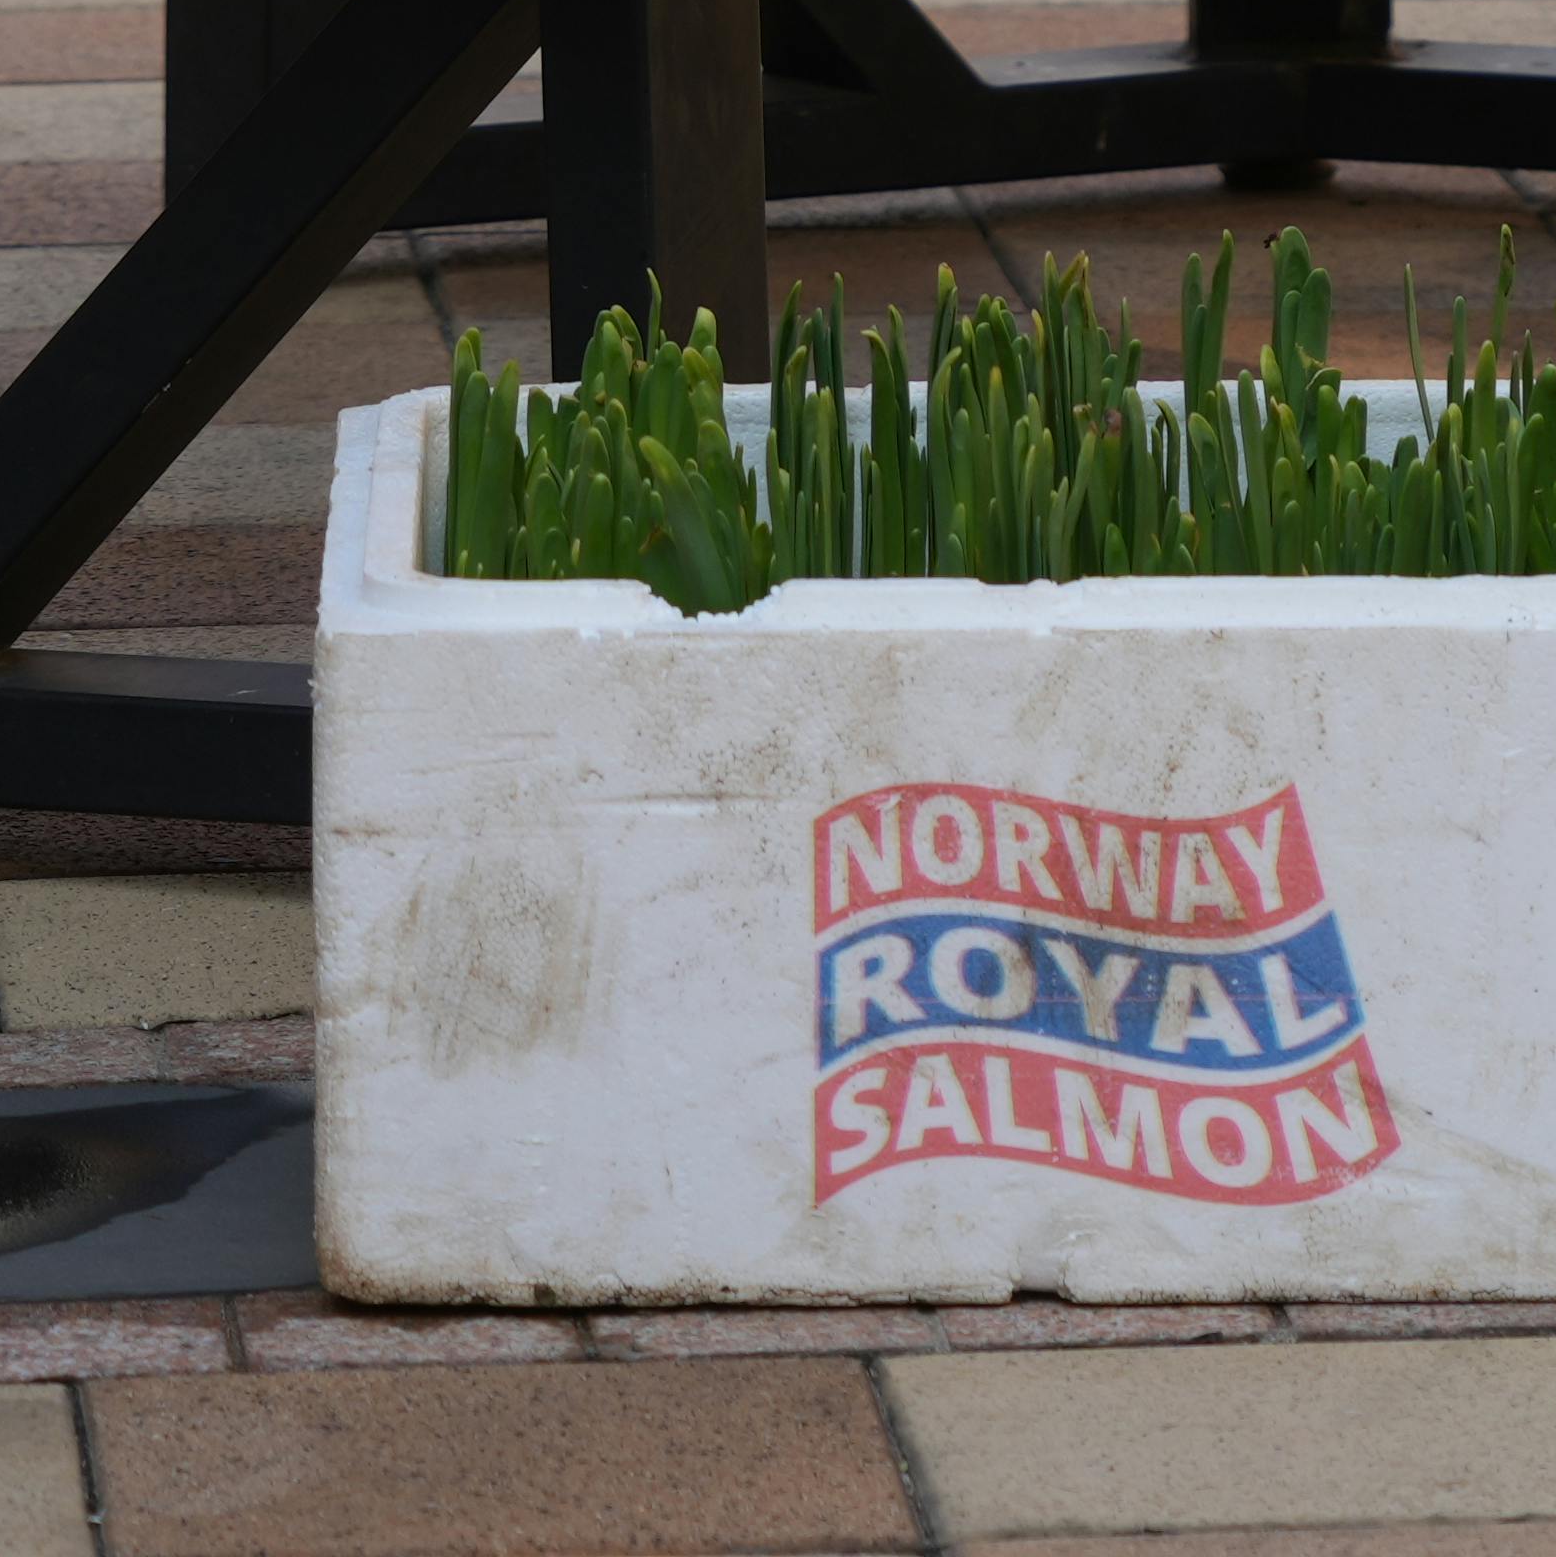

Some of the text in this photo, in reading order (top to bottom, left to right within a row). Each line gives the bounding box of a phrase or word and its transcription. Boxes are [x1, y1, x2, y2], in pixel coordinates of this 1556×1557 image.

[828, 793, 1285, 925] NORWAY
[830, 926, 1347, 1058] ROYAL
[828, 1052, 1380, 1188] SALMON
